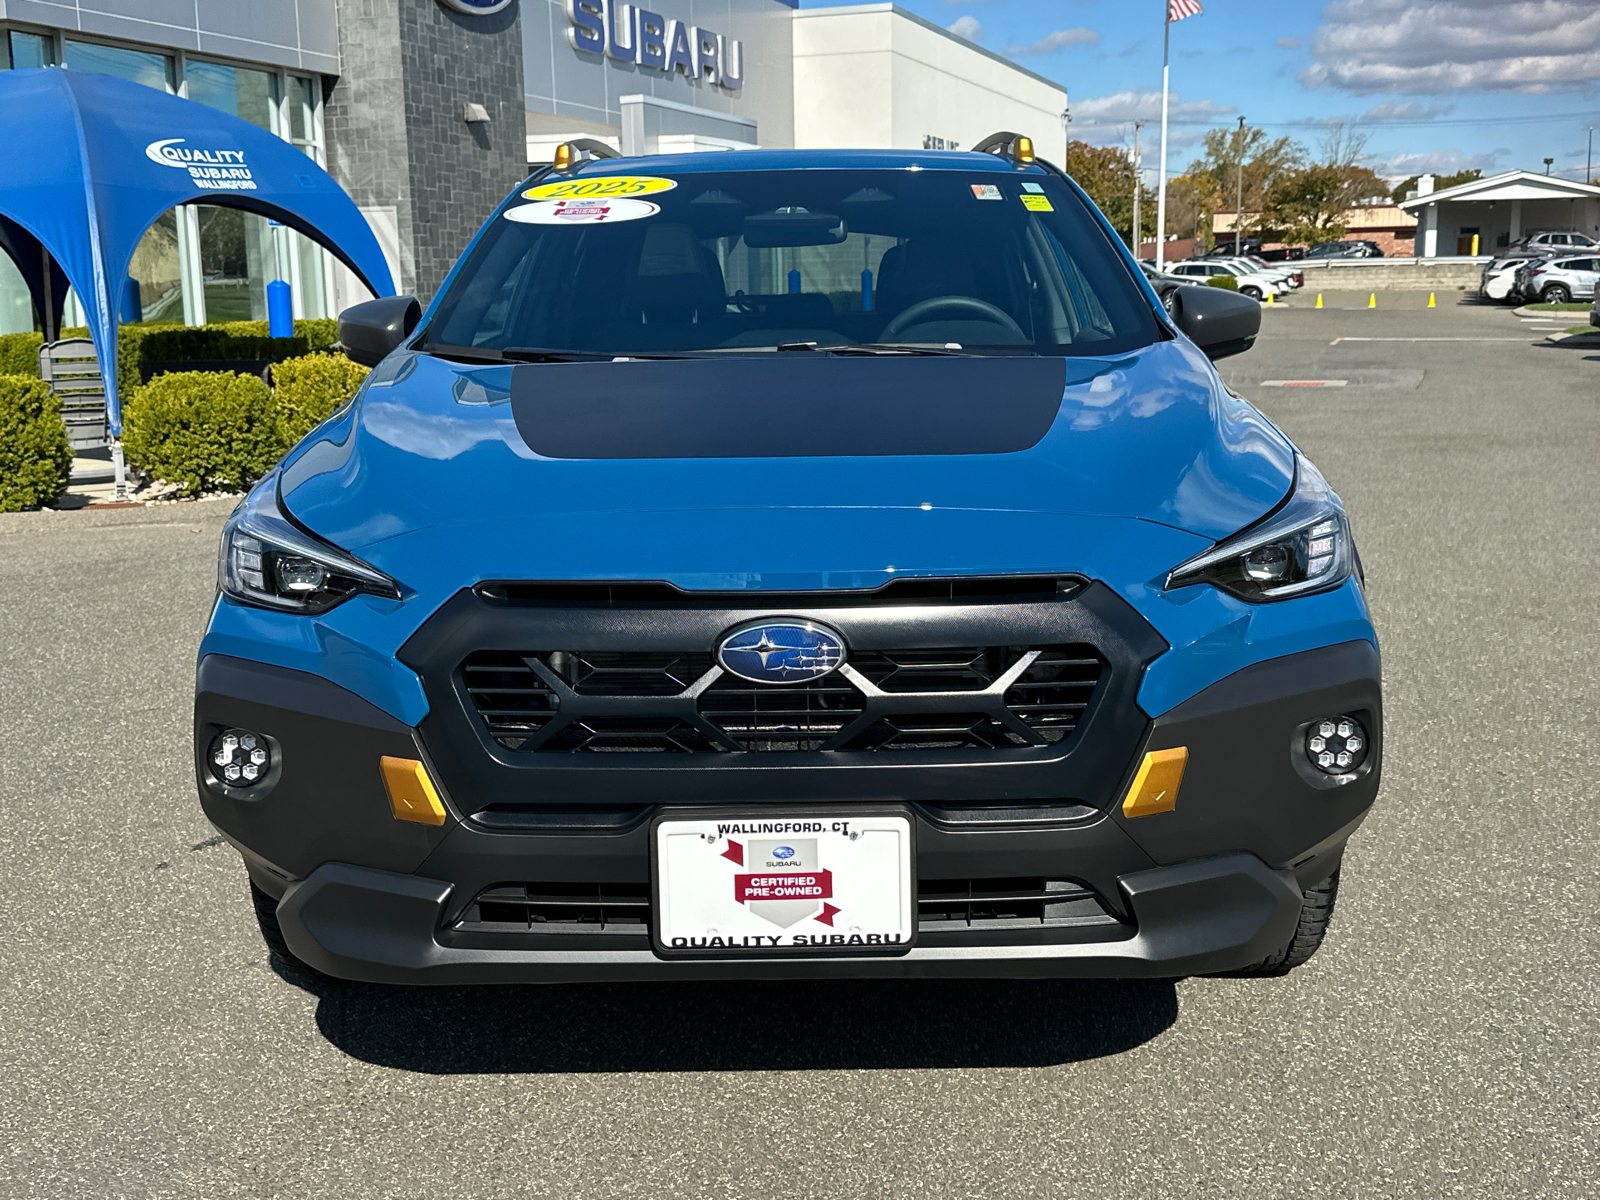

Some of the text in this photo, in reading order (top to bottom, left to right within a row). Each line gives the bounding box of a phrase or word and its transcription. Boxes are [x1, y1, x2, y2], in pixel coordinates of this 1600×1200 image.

[567, 0, 744, 90] SUBARU
[162, 147, 244, 163] QUALITY
[188, 167, 252, 179] SUBARU
[193, 179, 257, 189] WALLINGFORD
[546, 180, 654, 197] 2025
[717, 822, 849, 834] WALLINGFORD, CT
[751, 877, 816, 886] CERTIFIED
[744, 887, 823, 897] PRE-OWNED
[671, 932, 901, 947] QUALITY SUBARU
